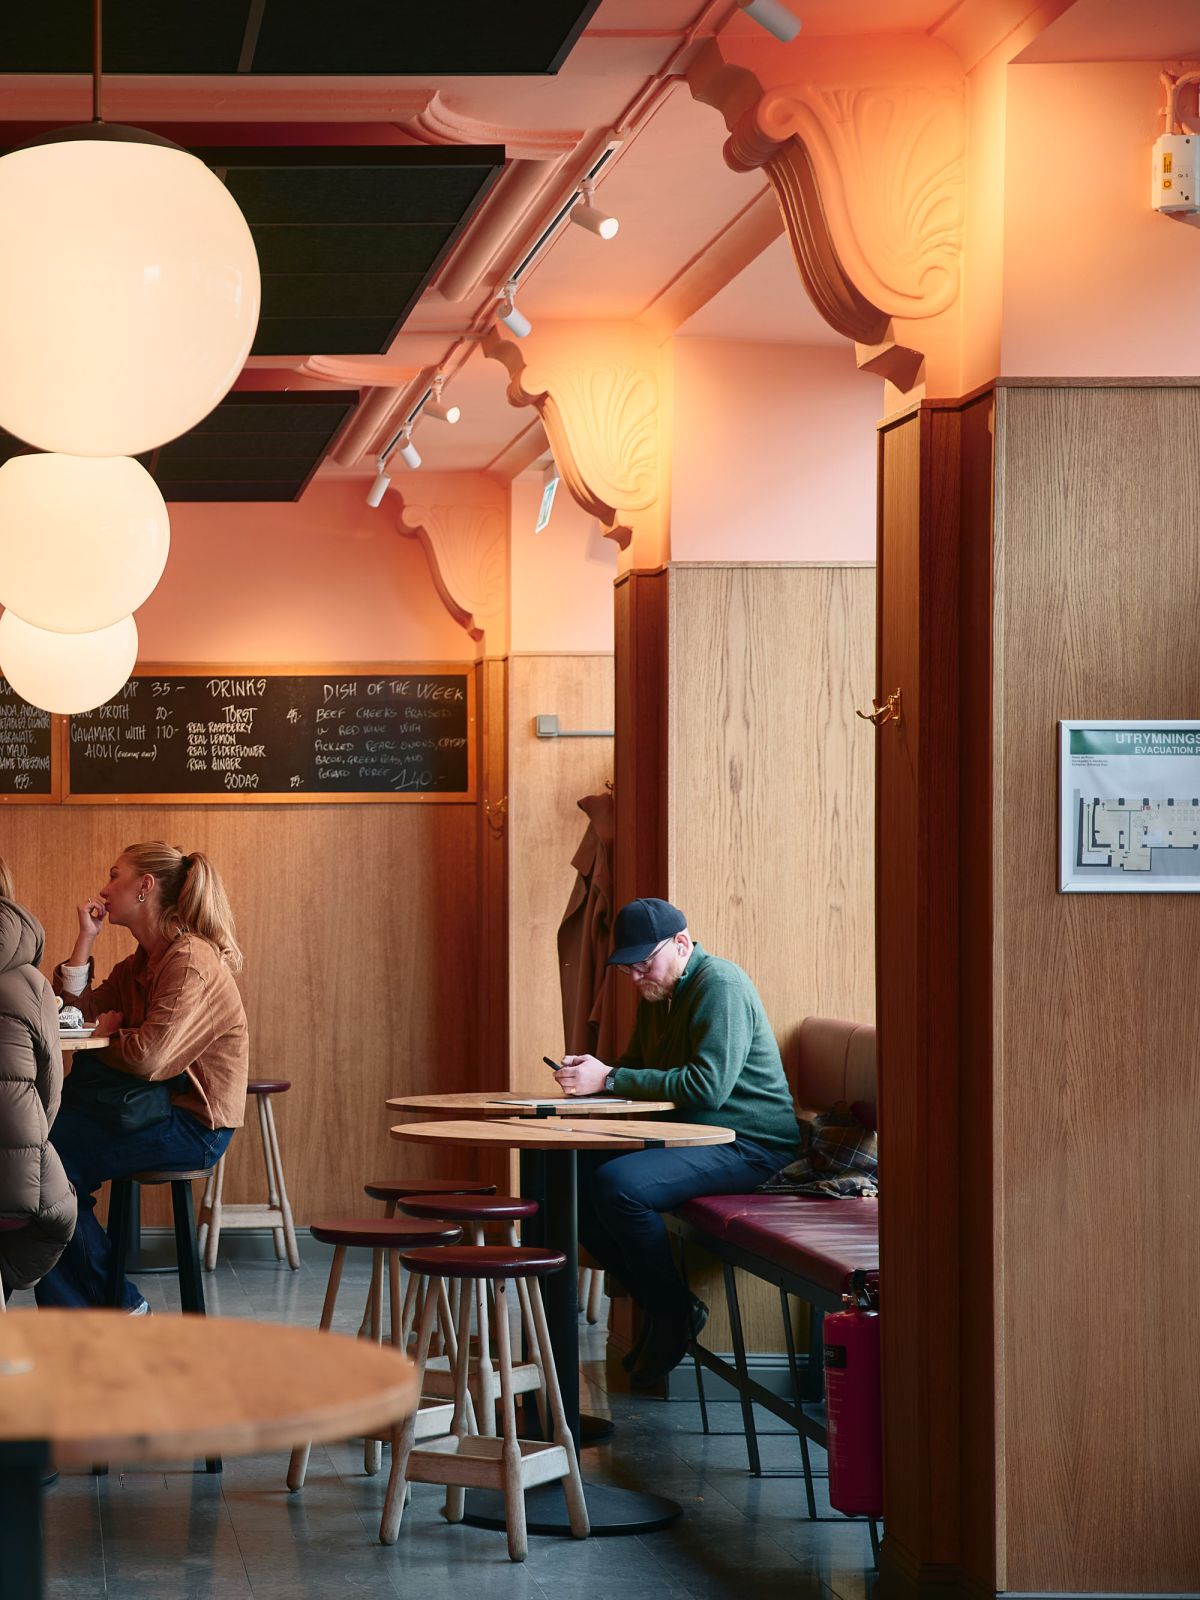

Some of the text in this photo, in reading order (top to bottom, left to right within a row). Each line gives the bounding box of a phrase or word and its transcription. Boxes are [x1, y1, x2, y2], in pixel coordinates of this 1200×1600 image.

[206, 679, 266, 697] DRINKS
[323, 681, 463, 703] DISH OF THE WEEK
[316, 708, 450, 722] BEEF CHEEKS BRAISED
[71, 722, 120, 742] CALAMARI
[125, 724, 146, 740] WITH
[186, 722, 253, 734] REAL RASPBERRY
[339, 725, 358, 735] RED
[188, 734, 236, 745] REAL LEMON
[315, 740, 354, 751] PICKLED
[366, 740, 396, 751] PEARL
[85, 744, 112, 758] AIOLI
[187, 745, 266, 757] REAL ELDERFLOWER
[1135, 746, 1194, 754] EVACUATION
[186, 757, 242, 771] REAL GINGER
[347, 755, 376, 764] GREEN
[404, 754, 423, 763] AND
[224, 772, 259, 789] SODAS
